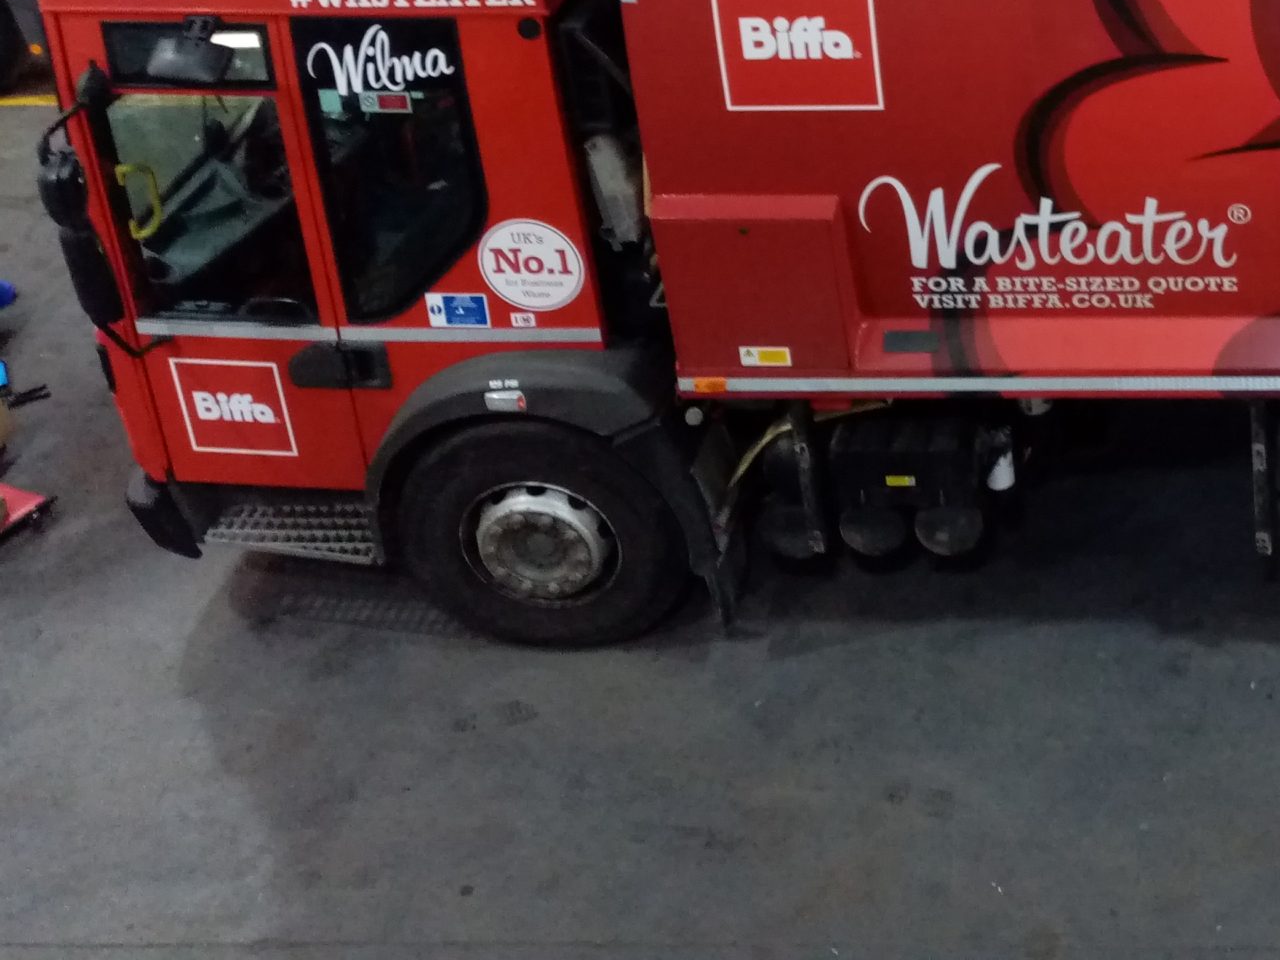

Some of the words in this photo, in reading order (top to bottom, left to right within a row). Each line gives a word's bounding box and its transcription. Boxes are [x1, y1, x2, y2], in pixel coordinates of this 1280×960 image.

[738, 15, 854, 61] Biffa
[306, 24, 456, 97] Wilma
[489, 247, 573, 275] No.1
[910, 276, 966, 293] FOR
[972, 276, 991, 293] A
[995, 276, 1141, 293] BITE-SIZED
[1149, 276, 1239, 295] QUOTE
[912, 293, 982, 309] VISIT
[191, 391, 276, 423] Biffa
